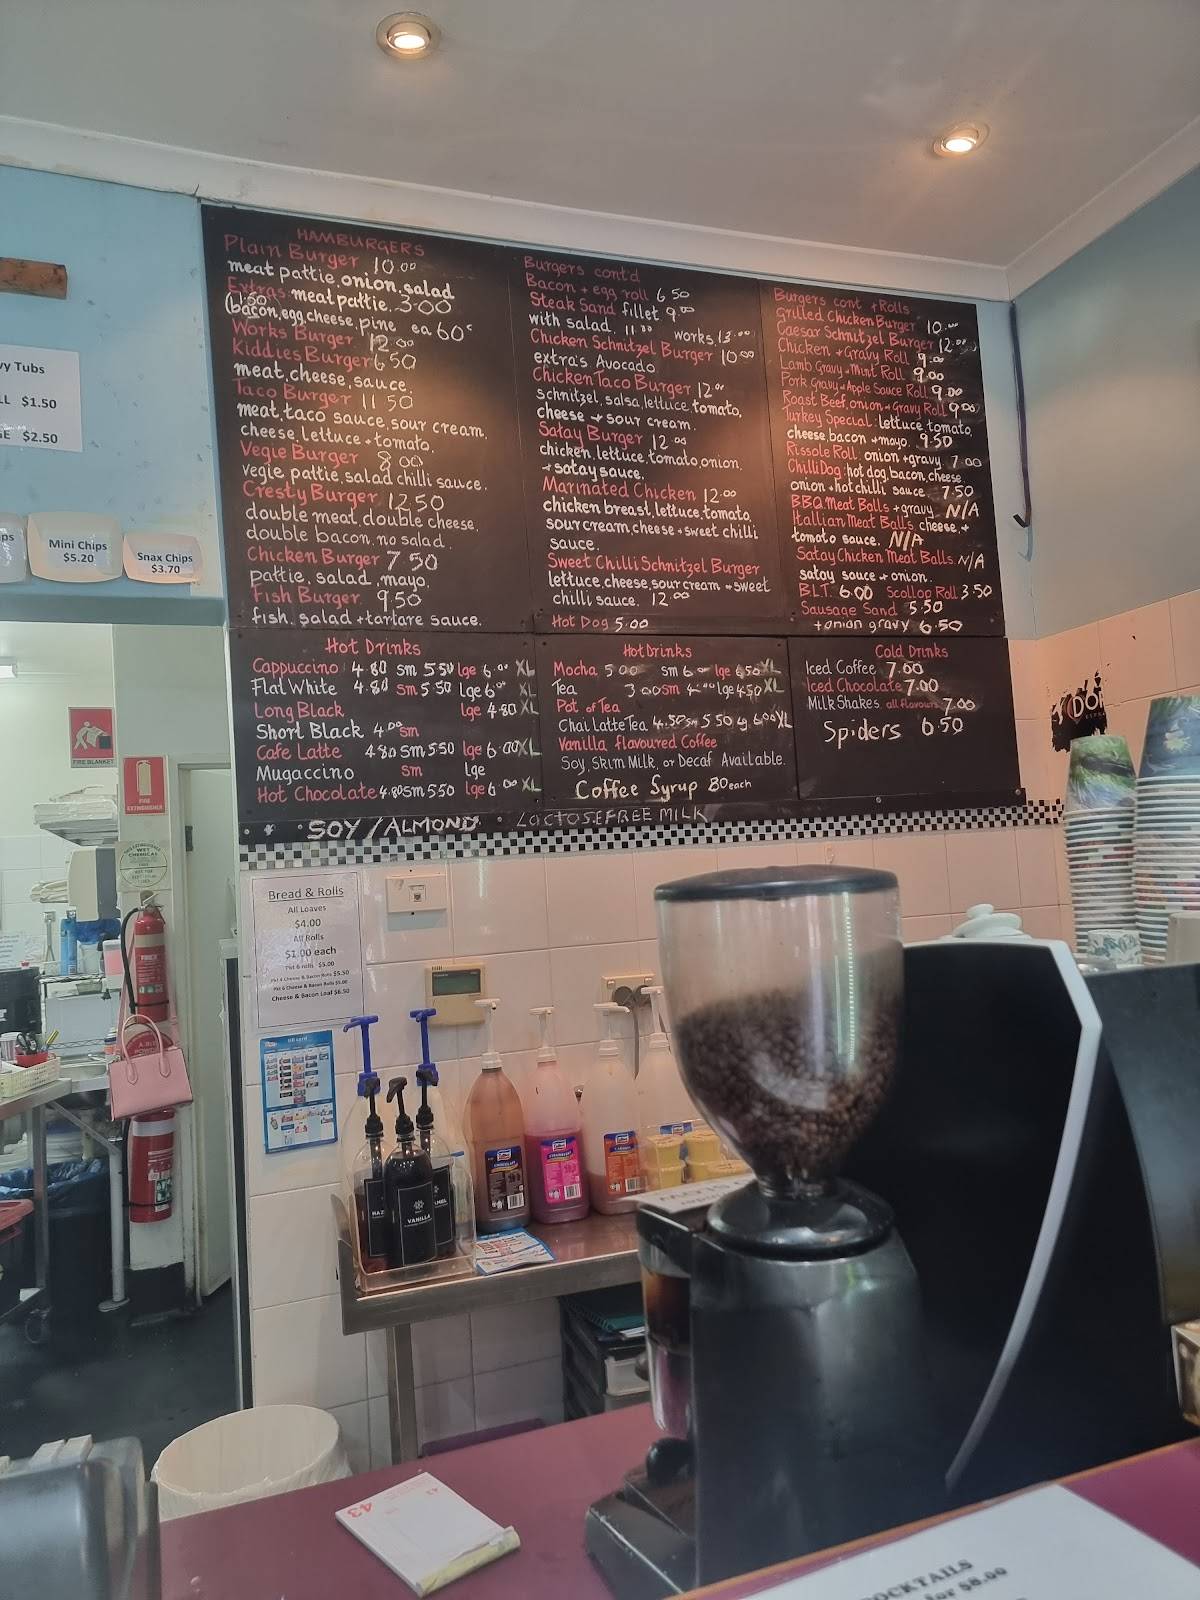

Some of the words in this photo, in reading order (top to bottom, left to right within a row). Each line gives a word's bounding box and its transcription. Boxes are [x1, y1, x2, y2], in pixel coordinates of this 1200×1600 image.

[224, 234, 280, 257] Plain
[289, 243, 360, 269] Burger
[297, 228, 425, 256] HAMBURGERS
[524, 255, 584, 276] Burgers
[530, 291, 576, 311] Steak
[580, 299, 617, 316] Sand
[232, 319, 287, 340] Works
[294, 323, 353, 350] Burger
[776, 321, 821, 338] Caesar
[824, 326, 884, 350] Schnitzel
[889, 332, 934, 352] Burger
[232, 338, 301, 361] Kiddies
[305, 345, 372, 372] Burger
[530, 327, 588, 349] Chicken
[593, 336, 656, 358] Schnitzel
[661, 343, 713, 366] Burger
[14, 361, 45, 375] Tubs
[596, 354, 656, 373] Avocado
[21, 395, 57, 410] $1.50
[22, 430, 58, 445] $2.50
[538, 421, 584, 448] Satay
[587, 426, 643, 450] Burger
[240, 440, 287, 464] Vegie
[292, 443, 359, 468] Burger
[243, 480, 307, 505] Cresty
[310, 484, 378, 509] Burger
[543, 476, 629, 498] Marinated
[633, 482, 696, 501] Chicken
[48, 539, 75, 550] Mini
[78, 540, 108, 552] Chips
[63, 552, 94, 565] $5.20
[137, 551, 163, 563] Snax
[165, 553, 194, 565] Chips
[247, 547, 317, 564] Chicken
[322, 548, 380, 571] Burger
[548, 552, 591, 570] Sweet
[596, 554, 638, 571] Chilli
[641, 555, 707, 578] Schnitzel
[711, 558, 761, 580] Burger
[796, 547, 836, 565] Satay
[837, 549, 883, 563] Chicken
[885, 549, 917, 564] Meat
[958, 552, 985, 572] N/A
[151, 564, 181, 575] $3.70
[252, 585, 292, 604] Fish
[298, 586, 361, 609] Burger
[801, 602, 857, 617] Sausage
[863, 602, 898, 616] Sand
[551, 614, 575, 629] Hot
[581, 616, 608, 630] Dog
[325, 637, 358, 656] Hot
[366, 638, 422, 657] Drinks
[623, 643, 644, 657] Hot
[646, 645, 693, 659] Drinks
[875, 643, 904, 659] Cold
[909, 644, 949, 658] Drinks
[252, 658, 339, 677] Cappuccino
[397, 663, 417, 677] sm
[457, 662, 477, 680] lge
[515, 658, 535, 678] XL
[553, 661, 599, 677] Mocha
[805, 660, 831, 676] Iced
[836, 659, 877, 675] Coffee
[251, 677, 287, 697] Flat
[291, 678, 338, 696] White
[805, 678, 834, 693] Iced
[837, 677, 902, 693] Chocolate
[254, 702, 293, 722] Long
[297, 701, 345, 718] Black
[460, 702, 481, 721] lge
[556, 700, 579, 713] Pot
[586, 702, 597, 713] of
[597, 697, 620, 714] Tea
[808, 695, 835, 711] Milk
[837, 694, 880, 710] Shakes
[256, 720, 304, 740] Short
[310, 718, 365, 739] Black
[399, 725, 419, 738] sm
[823, 718, 902, 750] Spiders
[297, 742, 343, 760] Latte
[558, 735, 608, 752] Vanilla
[614, 734, 677, 750] flavoured
[681, 733, 718, 749] Coffee
[678, 751, 712, 768] Decaf
[256, 763, 355, 785] Mugaccino
[401, 763, 423, 777] sm
[464, 762, 486, 783] lge
[257, 785, 288, 803] Hot
[294, 782, 378, 802] Chocolate
[575, 777, 639, 800] Coffee
[650, 774, 699, 802] Syrup
[659, 806, 708, 823] MILK
[307, 819, 361, 839] SOY
[268, 888, 301, 900] Bread
[305, 887, 314, 897] &
[318, 886, 344, 896] Rolls
[288, 906, 298, 914] All
[300, 905, 327, 913] Loaves
[295, 918, 322, 929] $4.00
[285, 949, 312, 959] $1.00
[314, 946, 337, 957] each
[407, 1214, 431, 1225] VANILLA
